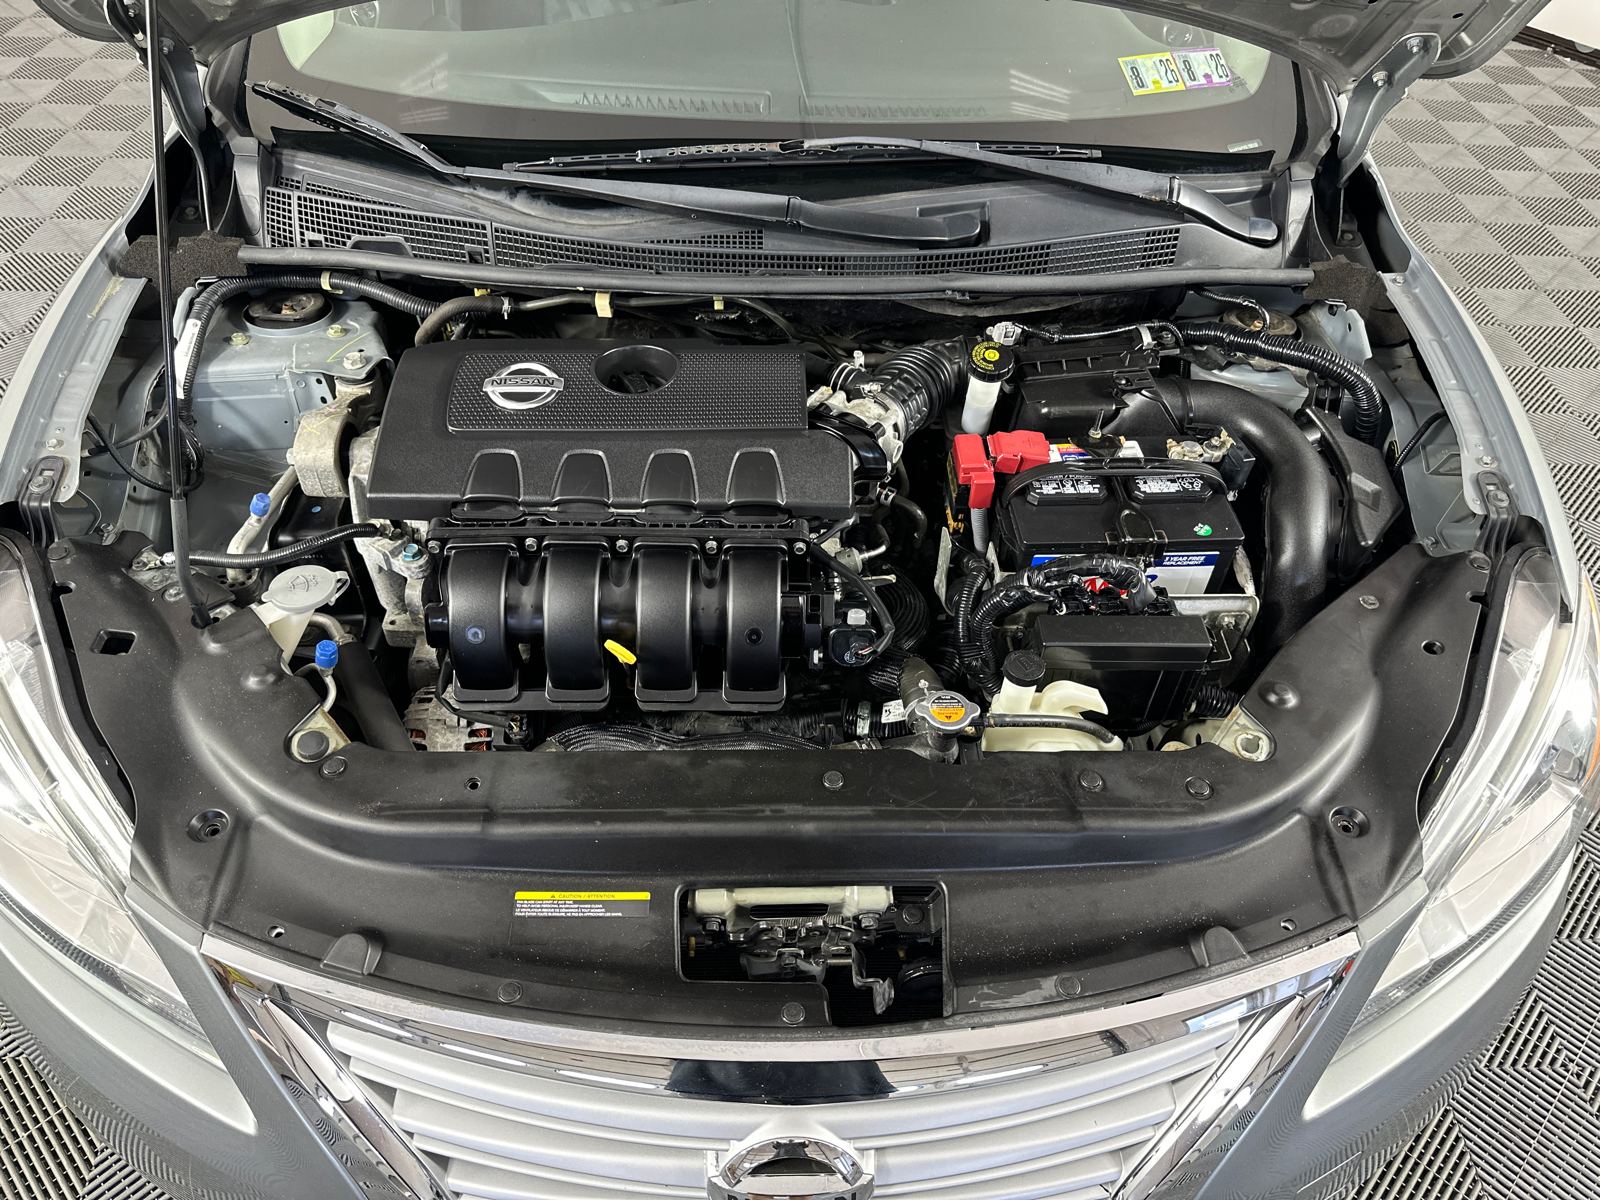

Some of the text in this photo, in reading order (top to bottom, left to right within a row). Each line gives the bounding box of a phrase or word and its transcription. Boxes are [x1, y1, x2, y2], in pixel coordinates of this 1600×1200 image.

[1130, 66, 1145, 89] 8
[1159, 58, 1180, 84] 26
[1182, 59, 1197, 82] 8
[1209, 53, 1230, 79] 26
[490, 377, 555, 386] NISSAN
